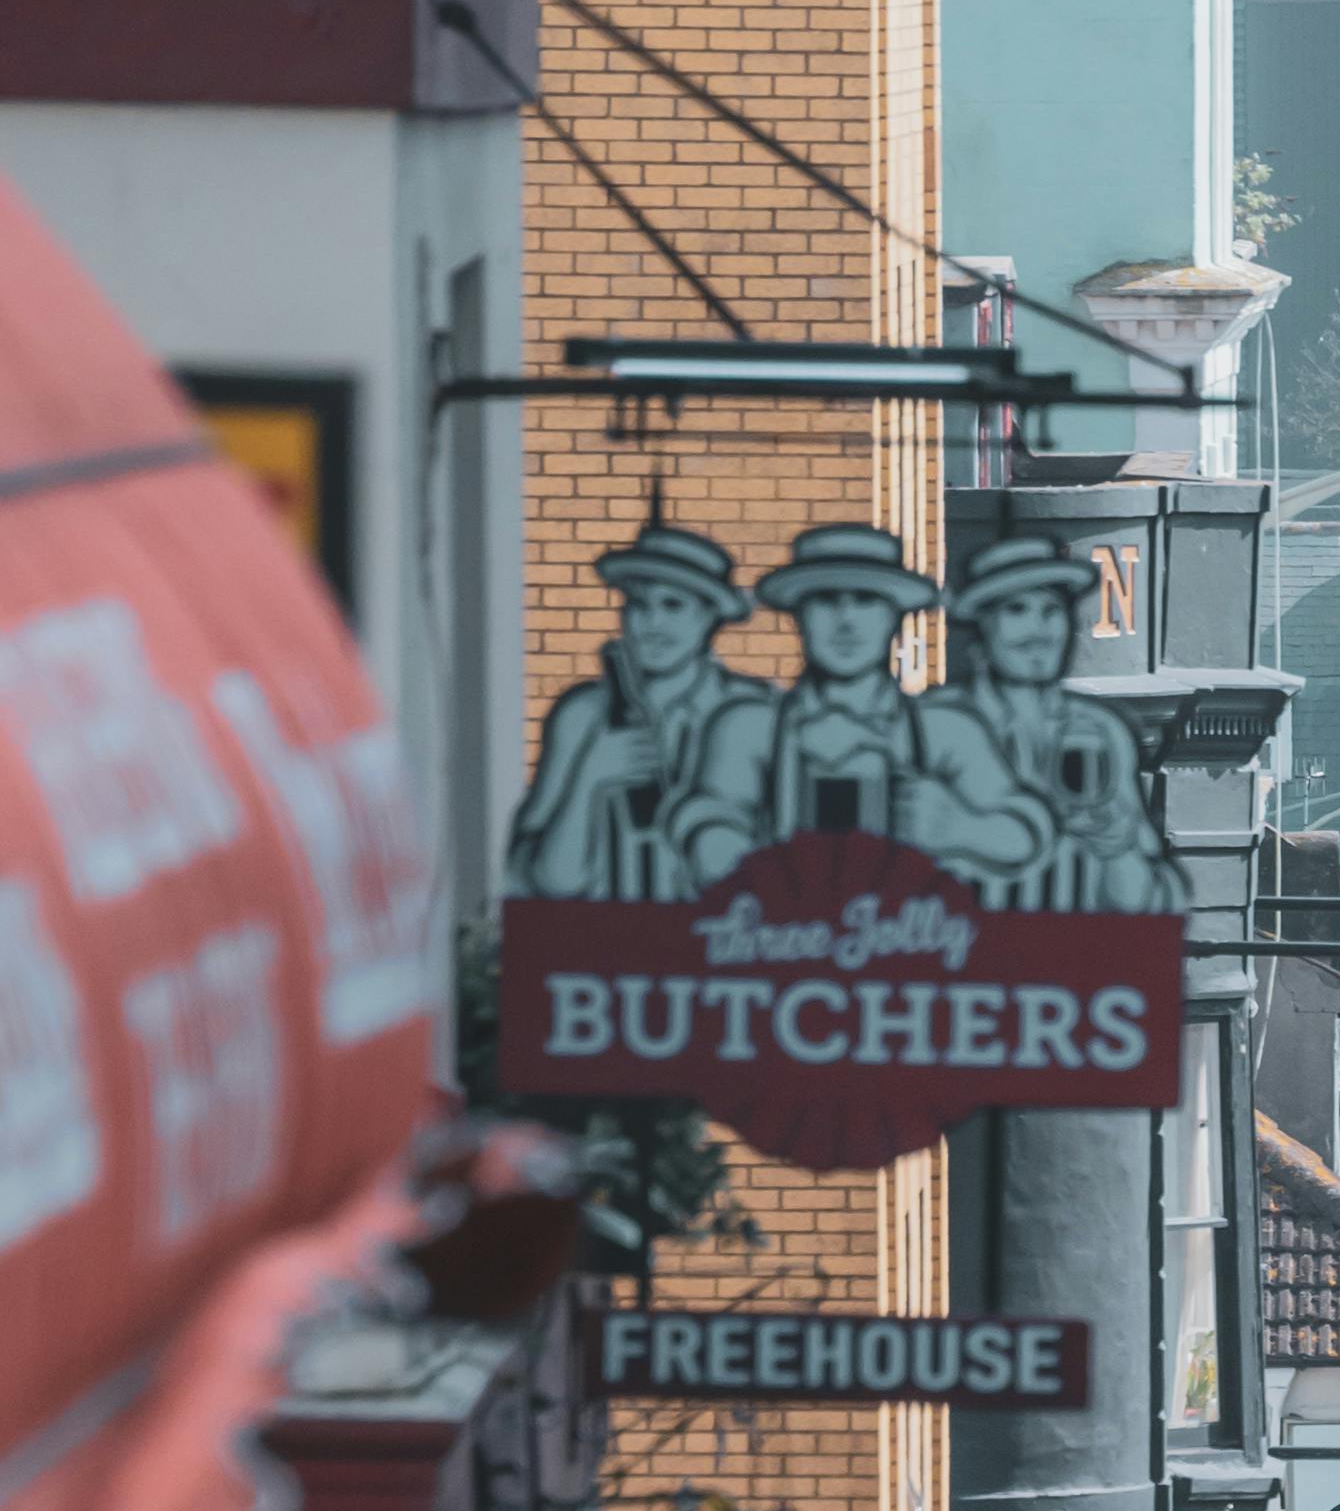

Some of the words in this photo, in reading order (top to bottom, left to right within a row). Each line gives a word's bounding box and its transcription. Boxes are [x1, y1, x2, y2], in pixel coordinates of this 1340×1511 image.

[833, 892, 978, 970] Jolly
[545, 974, 1149, 1070] BUTCHERS
[602, 1316, 1063, 1392] FREEHOUSE
